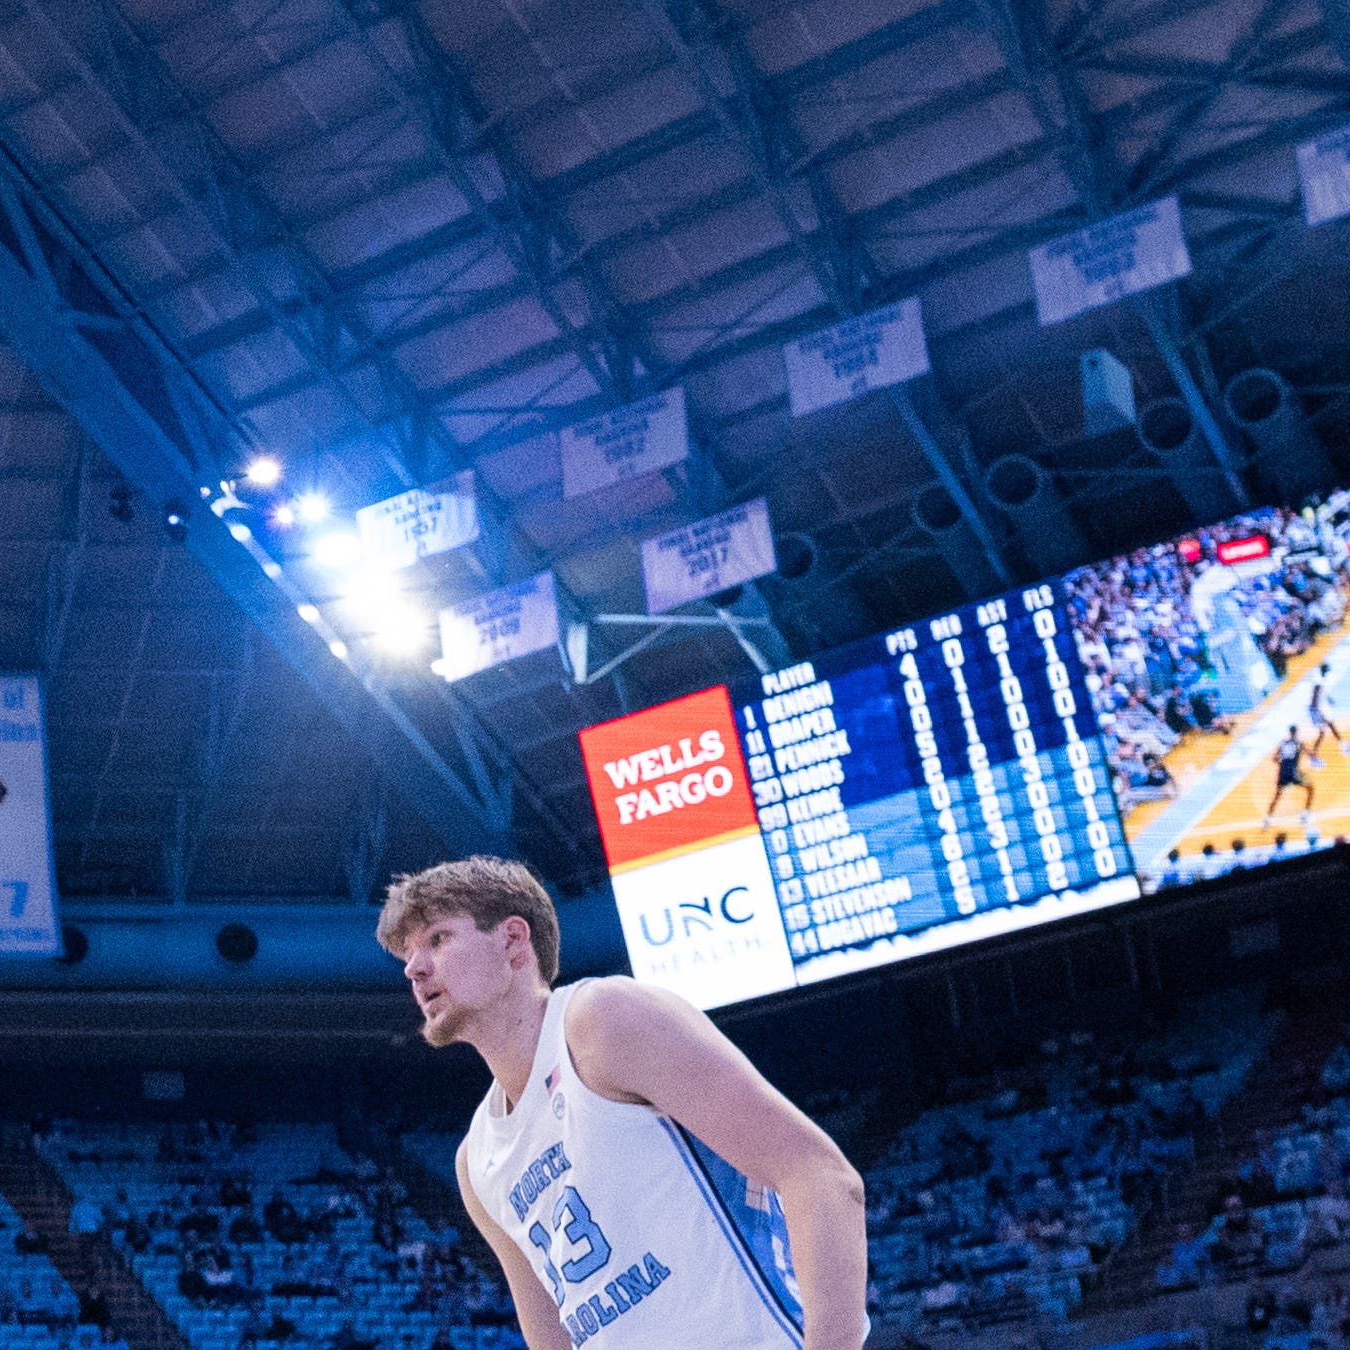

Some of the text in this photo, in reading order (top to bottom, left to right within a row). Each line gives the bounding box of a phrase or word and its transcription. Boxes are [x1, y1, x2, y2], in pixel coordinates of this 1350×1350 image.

[744, 706, 756, 729] 1
[900, 654, 919, 680] 4
[943, 639, 964, 667] 0
[987, 624, 1009, 653] 2
[1034, 609, 1055, 638] 0
[603, 729, 726, 790] WELLS
[747, 729, 766, 755] 11
[614, 765, 734, 825] FARGO
[752, 760, 844, 805] 30 WOODS
[771, 829, 788, 853] 0
[793, 811, 850, 848] EVANS
[799, 833, 868, 872] WILSON
[640, 885, 756, 948] UNC
[811, 876, 912, 924] STEVENSON
[791, 929, 818, 955] 44
[509, 1141, 572, 1222] NORTH
[529, 1186, 612, 1308] 13
[561, 1252, 671, 1349] ROLINA
